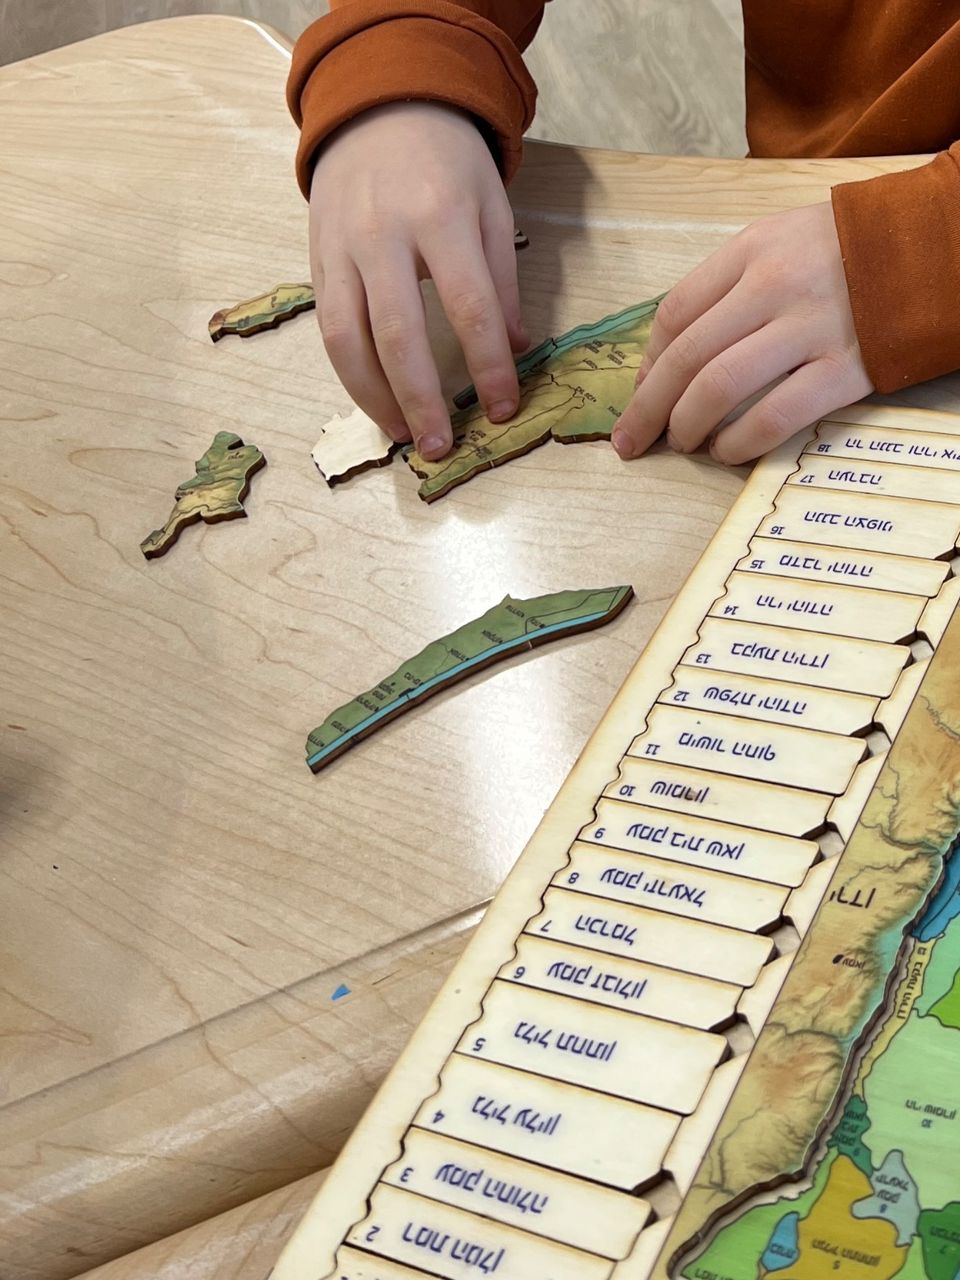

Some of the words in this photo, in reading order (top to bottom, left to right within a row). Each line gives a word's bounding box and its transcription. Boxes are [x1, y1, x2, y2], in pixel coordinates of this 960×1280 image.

[818, 443, 831, 453] 18
[845, 438, 863, 450] הר
[869, 440, 904, 454] הנגב
[908, 444, 938, 458] והרי
[800, 474, 815, 484] 17
[828, 470, 882, 486] הערבה
[770, 525, 784, 535] 16
[804, 511, 842, 525] הנגב
[845, 515, 893, 533] הצפוני
[750, 559, 766, 570] 15
[779, 555, 823, 571] מדבר
[828, 562, 873, 578] יהודה
[724, 605, 739, 616] 14
[756, 595, 783, 610] הרי
[787, 599, 833, 617] יהודה
[696, 653, 711, 664] 13
[730, 642, 780, 661] בקעת
[782, 650, 830, 669] הירדן
[673, 690, 689, 702] 12
[704, 686, 756, 706] שפלת
[759, 696, 808, 716] יהודה
[646, 743, 661, 755] 11
[678, 732, 725, 753] מישור
[732, 742, 776, 761] החוף
[619, 785, 636, 797] 10
[650, 781, 710, 804] שומרון
[594, 827, 606, 839] 9
[626, 823, 669, 843] עמק
[671, 832, 704, 853] בית
[705, 841, 745, 861] שאן
[568, 872, 580, 883] 8
[600, 868, 644, 890] עמק
[643, 880, 707, 908] יזרעאל
[829, 886, 876, 909] ירדן
[541, 920, 553, 932] 7
[575, 915, 638, 946] הכרמל
[842, 958, 866, 970] עמאן
[513, 966, 526, 979] 6
[546, 962, 592, 986] עמק
[592, 974, 647, 1000] זבולון
[472, 1037, 486, 1052] 5
[513, 1021, 550, 1048] גליל
[555, 1032, 617, 1062] תחתון
[433, 1110, 445, 1124] 4
[471, 1096, 510, 1126] גליל
[513, 1109, 562, 1137] עליון
[905, 1099, 920, 1110] הרי
[922, 1102, 957, 1120] שומרון
[400, 1168, 414, 1182] 3
[435, 1163, 484, 1196] עמק
[482, 1178, 549, 1215] החולה
[366, 1226, 381, 1242] 2
[402, 1222, 450, 1254] רמת
[451, 1239, 507, 1274] הגולן
